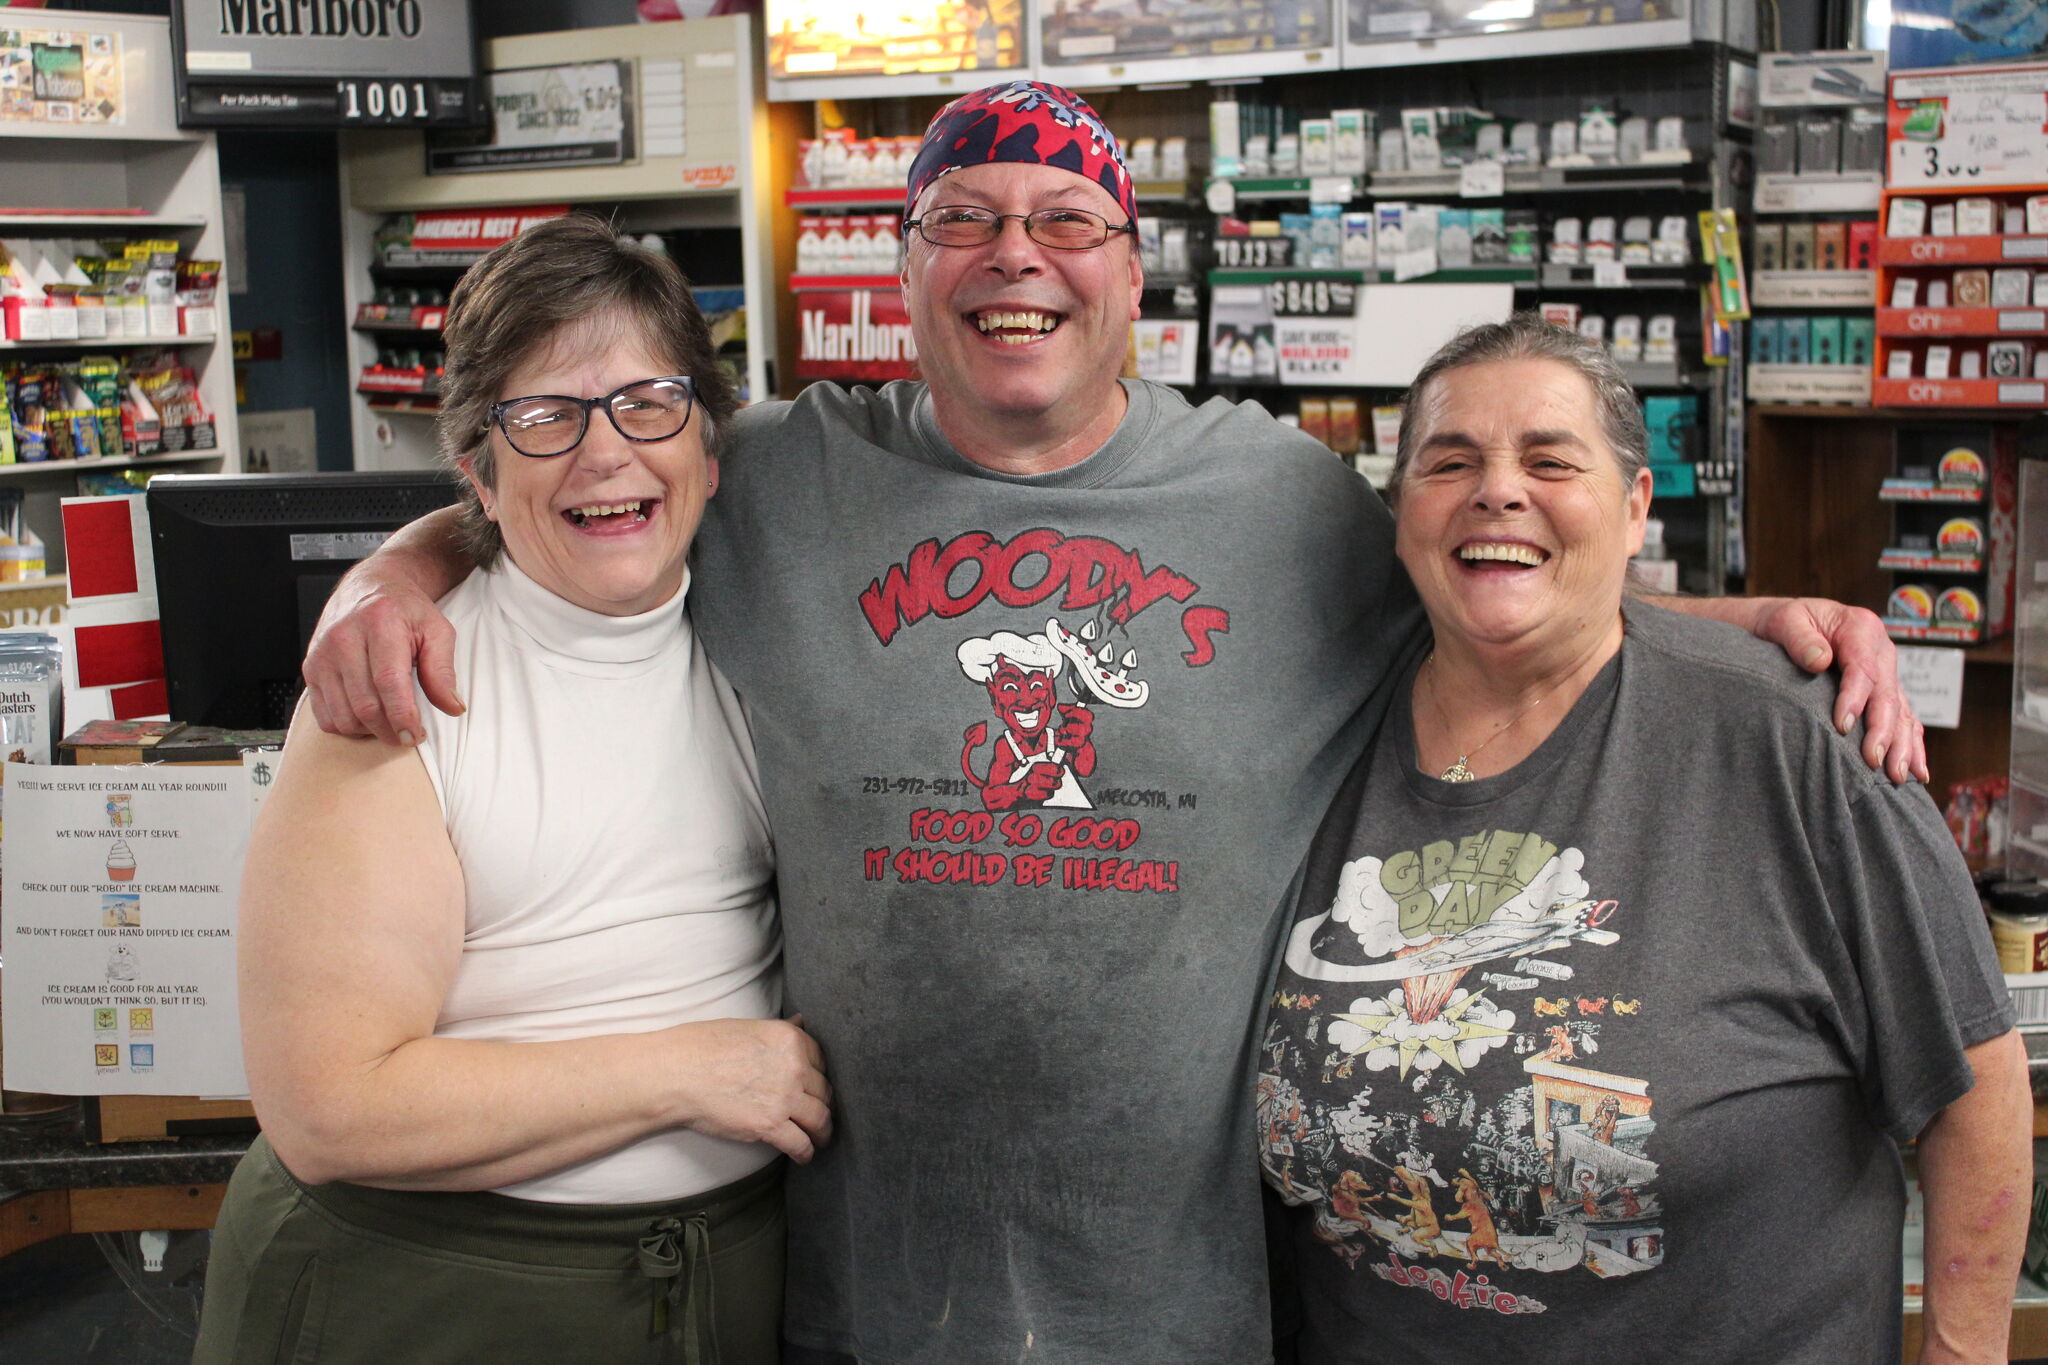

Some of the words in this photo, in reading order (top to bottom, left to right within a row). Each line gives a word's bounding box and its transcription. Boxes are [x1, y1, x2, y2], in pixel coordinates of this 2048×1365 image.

[221, 0, 421, 37] Marlboro
[220, 94, 238, 106] Per
[413, 218, 481, 239] AMERICA'S
[482, 216, 517, 238] BEST
[801, 291, 920, 362] Marlboro
[1281, 347, 1350, 359] MARLBORO
[1287, 361, 1342, 372] BLACK
[40, 782, 54, 791] WE
[57, 782, 86, 791] SERVE
[89, 783, 104, 791] ICE
[105, 783, 138, 791] CREAM
[141, 783, 156, 791] ALL
[159, 783, 182, 791] YEAR
[1179, 792, 1197, 810] MI
[56, 829, 71, 838] WE
[74, 829, 96, 838] NOW
[98, 830, 123, 838] HAVE
[125, 829, 147, 839] SOFT
[910, 808, 994, 844] FOOD
[1000, 813, 1043, 846] SO
[1047, 816, 1141, 851] GOOD
[864, 846, 890, 881] IT
[893, 846, 1008, 886] SHOULD
[1011, 853, 1056, 888] BE
[1063, 857, 1179, 894] ILLEGAL!
[1380, 829, 1558, 903] GREEN
[22, 882, 48, 892] CHECK
[50, 884, 67, 893] OUT
[70, 884, 89, 893] OUR
[128, 884, 142, 893] ICE
[144, 884, 177, 893] CREAM
[179, 884, 224, 894] MACHINE.
[1398, 879, 1525, 939] DAY
[16, 926, 32, 935] AND
[33, 927, 57, 936] DON'T
[60, 928, 94, 937] FORGET
[97, 929, 117, 937] OUR
[119, 929, 144, 937] HAND
[146, 929, 179, 937] DIPPED
[181, 929, 194, 937] ICE
[197, 929, 233, 938] CREAM.
[48, 984, 61, 993] ICE
[63, 985, 96, 993] CREAM
[98, 985, 108, 993] IS
[110, 985, 135, 993] GOOD
[137, 985, 154, 993] FOR
[156, 985, 172, 993] ALL
[174, 985, 198, 993] YEAR
[42, 996, 62, 1005] (YOU
[64, 997, 111, 1005] WOULDN'T
[114, 997, 142, 1005] THINK
[161, 996, 180, 1005] BUT
[182, 996, 191, 1005] IT
[1386, 1252, 1519, 1314] dookie
